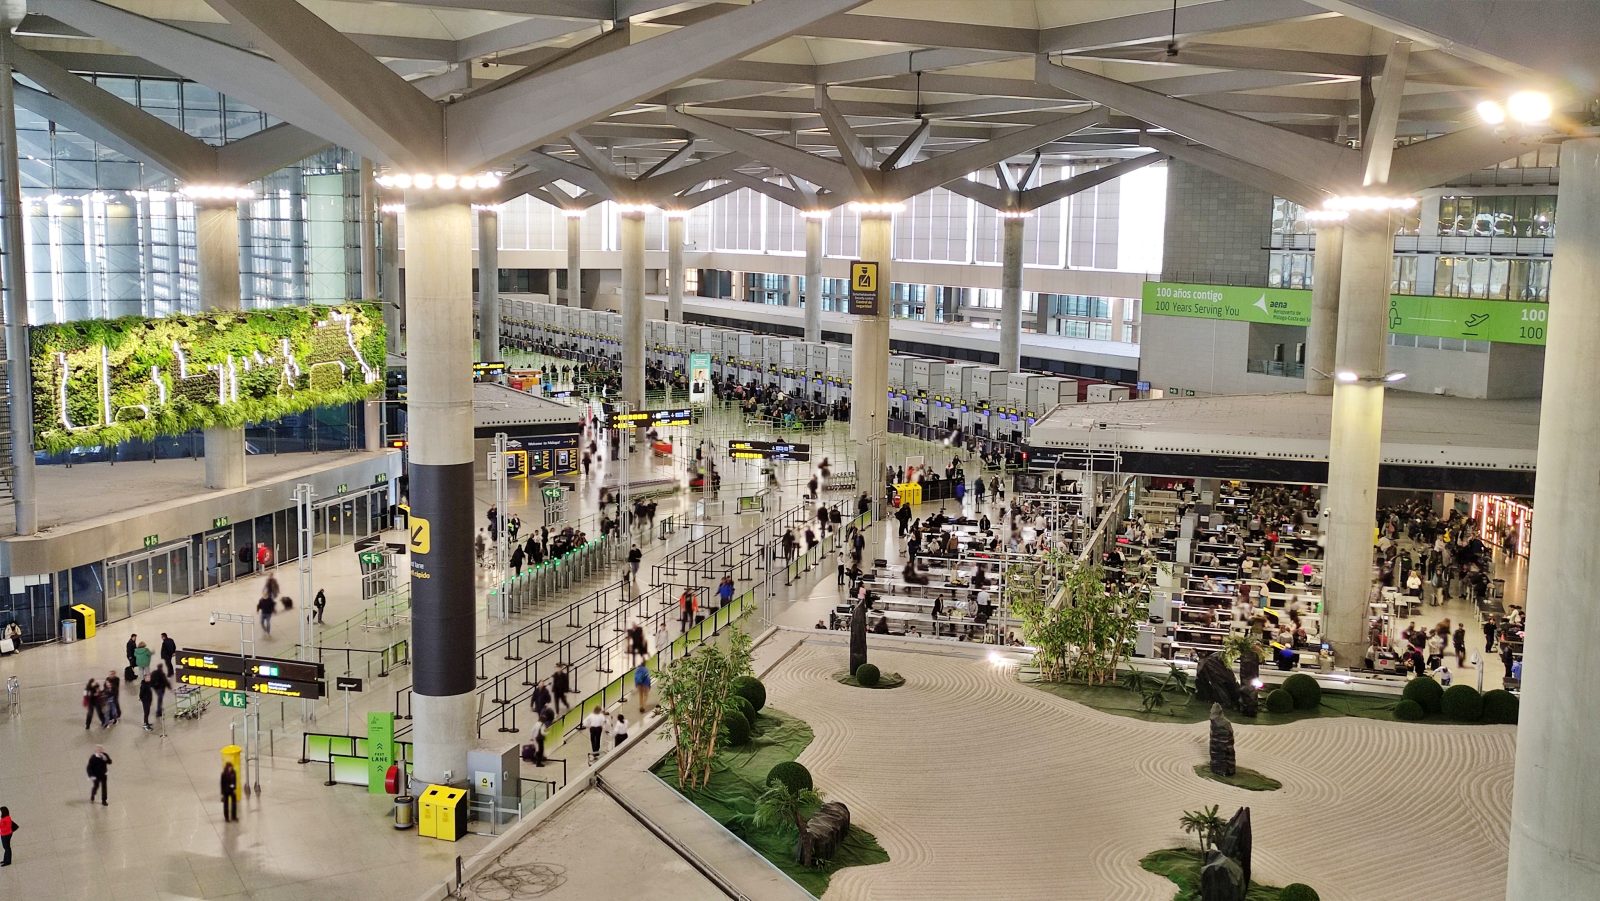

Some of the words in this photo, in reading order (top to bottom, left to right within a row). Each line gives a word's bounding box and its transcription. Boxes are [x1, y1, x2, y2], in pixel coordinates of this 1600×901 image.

[1156, 287, 1172, 298] 100
[1173, 288, 1191, 299] años
[1193, 290, 1223, 303] contigo
[1155, 301, 1170, 311] 100
[1173, 302, 1192, 313] Years
[1194, 303, 1223, 317] Serving
[1225, 305, 1240, 316] You
[1269, 301, 1288, 309] aena
[1521, 309, 1546, 321] 100
[1520, 326, 1543, 339] 100
